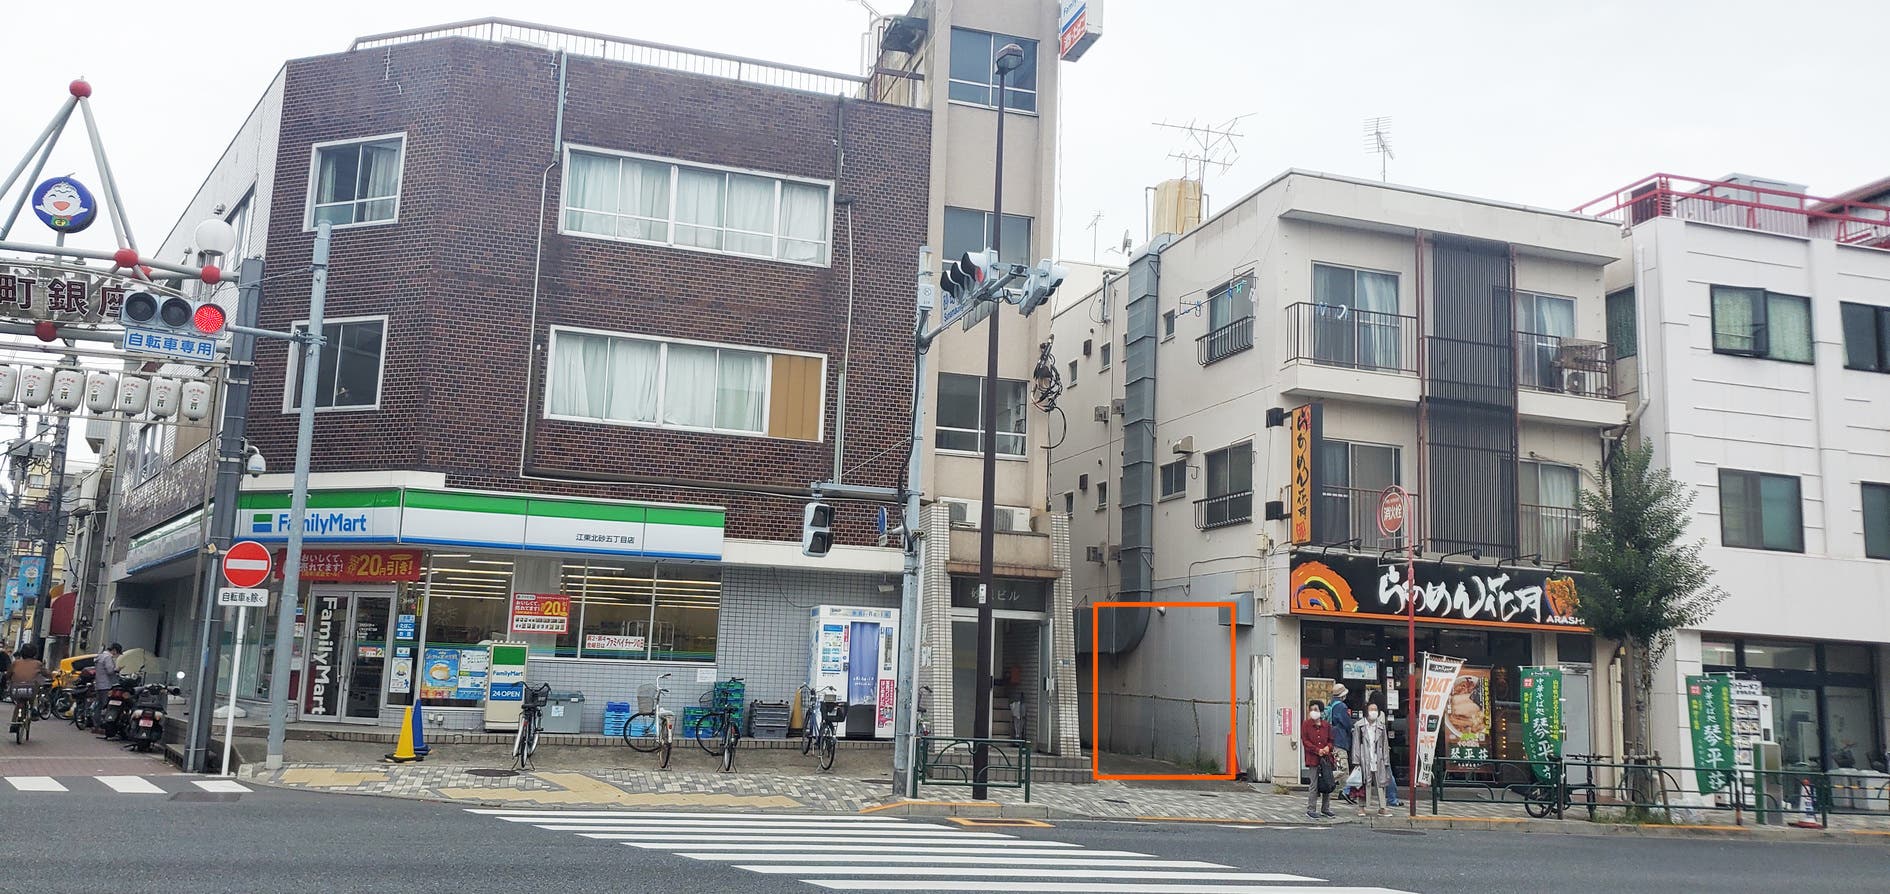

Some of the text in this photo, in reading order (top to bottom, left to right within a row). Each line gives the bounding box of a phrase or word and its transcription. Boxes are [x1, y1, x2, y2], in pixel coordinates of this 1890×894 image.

[128, 333, 212, 357] 自転車専用
[222, 592, 264, 603] 自転車を除く
[311, 597, 338, 715] FamilyMart
[501, 690, 520, 698] OPEN
